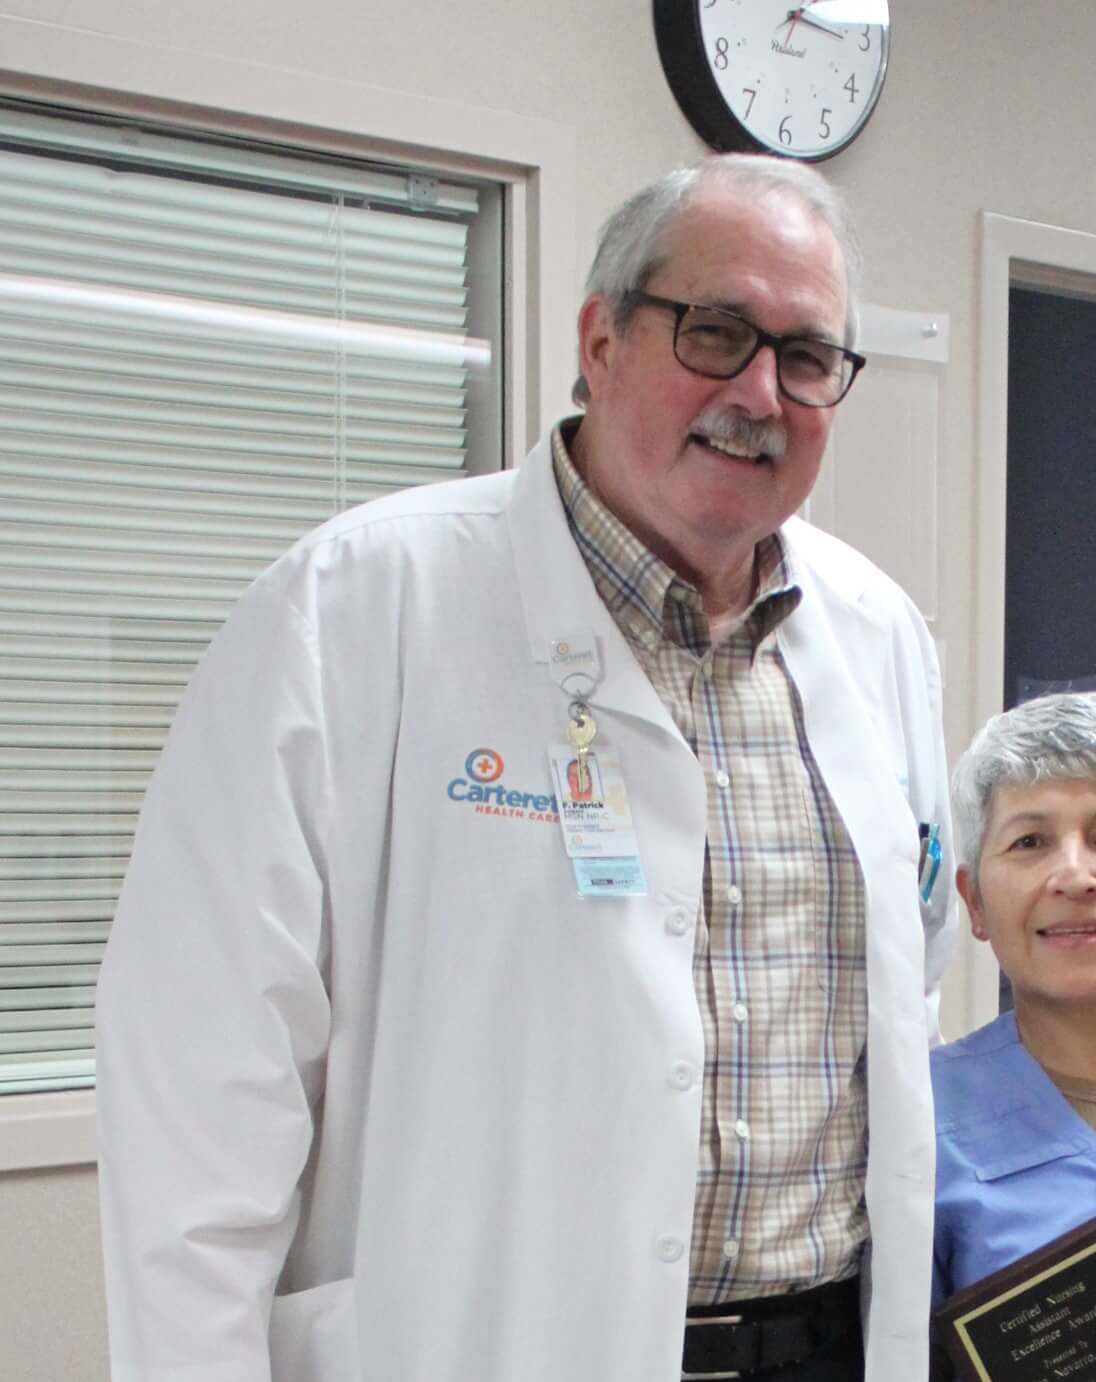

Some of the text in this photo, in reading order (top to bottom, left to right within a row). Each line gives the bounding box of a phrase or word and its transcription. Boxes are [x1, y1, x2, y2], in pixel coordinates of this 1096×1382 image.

[714, 37, 728, 70] 8
[843, 73, 859, 103] 4
[742, 88, 756, 120] 7
[779, 115, 792, 145] 6
[819, 108, 832, 139] 5
[475, 804, 524, 818] HEALTH
[999, 1281, 1085, 1331] Certified Nursing
[1029, 1307, 1070, 1333] Assistant
[1011, 1328, 1061, 1360] Excellence
